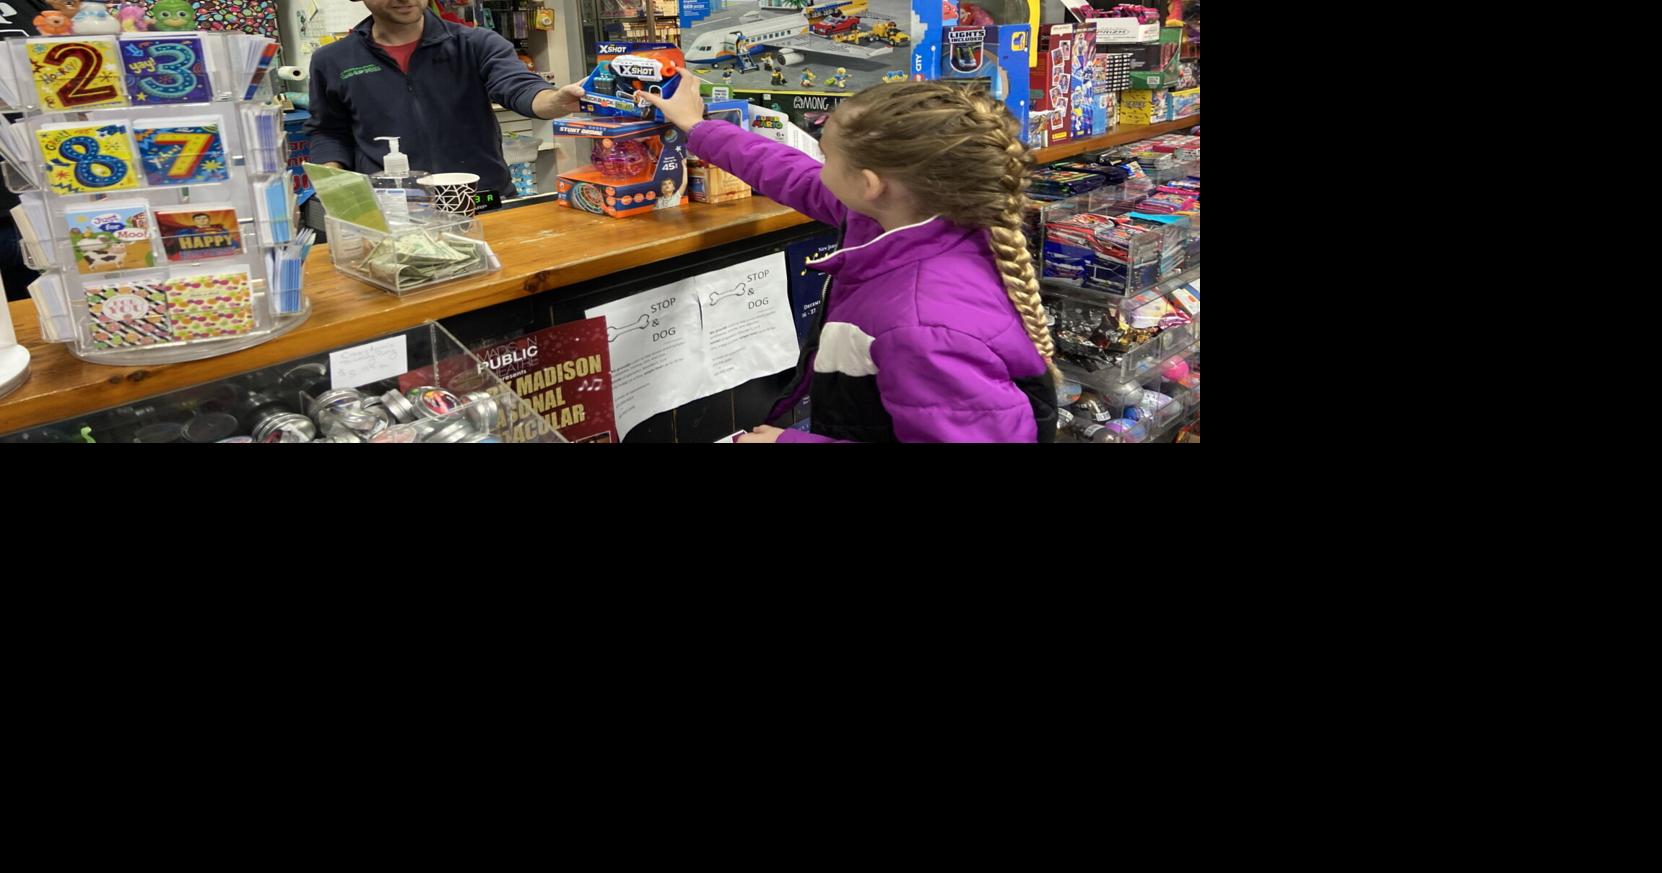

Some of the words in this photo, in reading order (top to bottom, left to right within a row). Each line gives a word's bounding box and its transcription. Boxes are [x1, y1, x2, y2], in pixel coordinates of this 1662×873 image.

[43, 43, 118, 107] 2
[138, 43, 197, 98] 3
[752, 119, 783, 129] MARIO
[58, 136, 128, 188] 8
[154, 133, 214, 179] 7
[94, 214, 117, 224] Just
[105, 224, 121, 232] for
[179, 234, 232, 250] HAPPY
[747, 269, 771, 283] STOP
[747, 287, 755, 296] &
[651, 296, 677, 314] STOP
[748, 297, 770, 310] DOG
[652, 318, 660, 328] &
[652, 327, 677, 343] DOG
[477, 345, 538, 375] PUBLIC
[516, 354, 603, 398] MADISON
